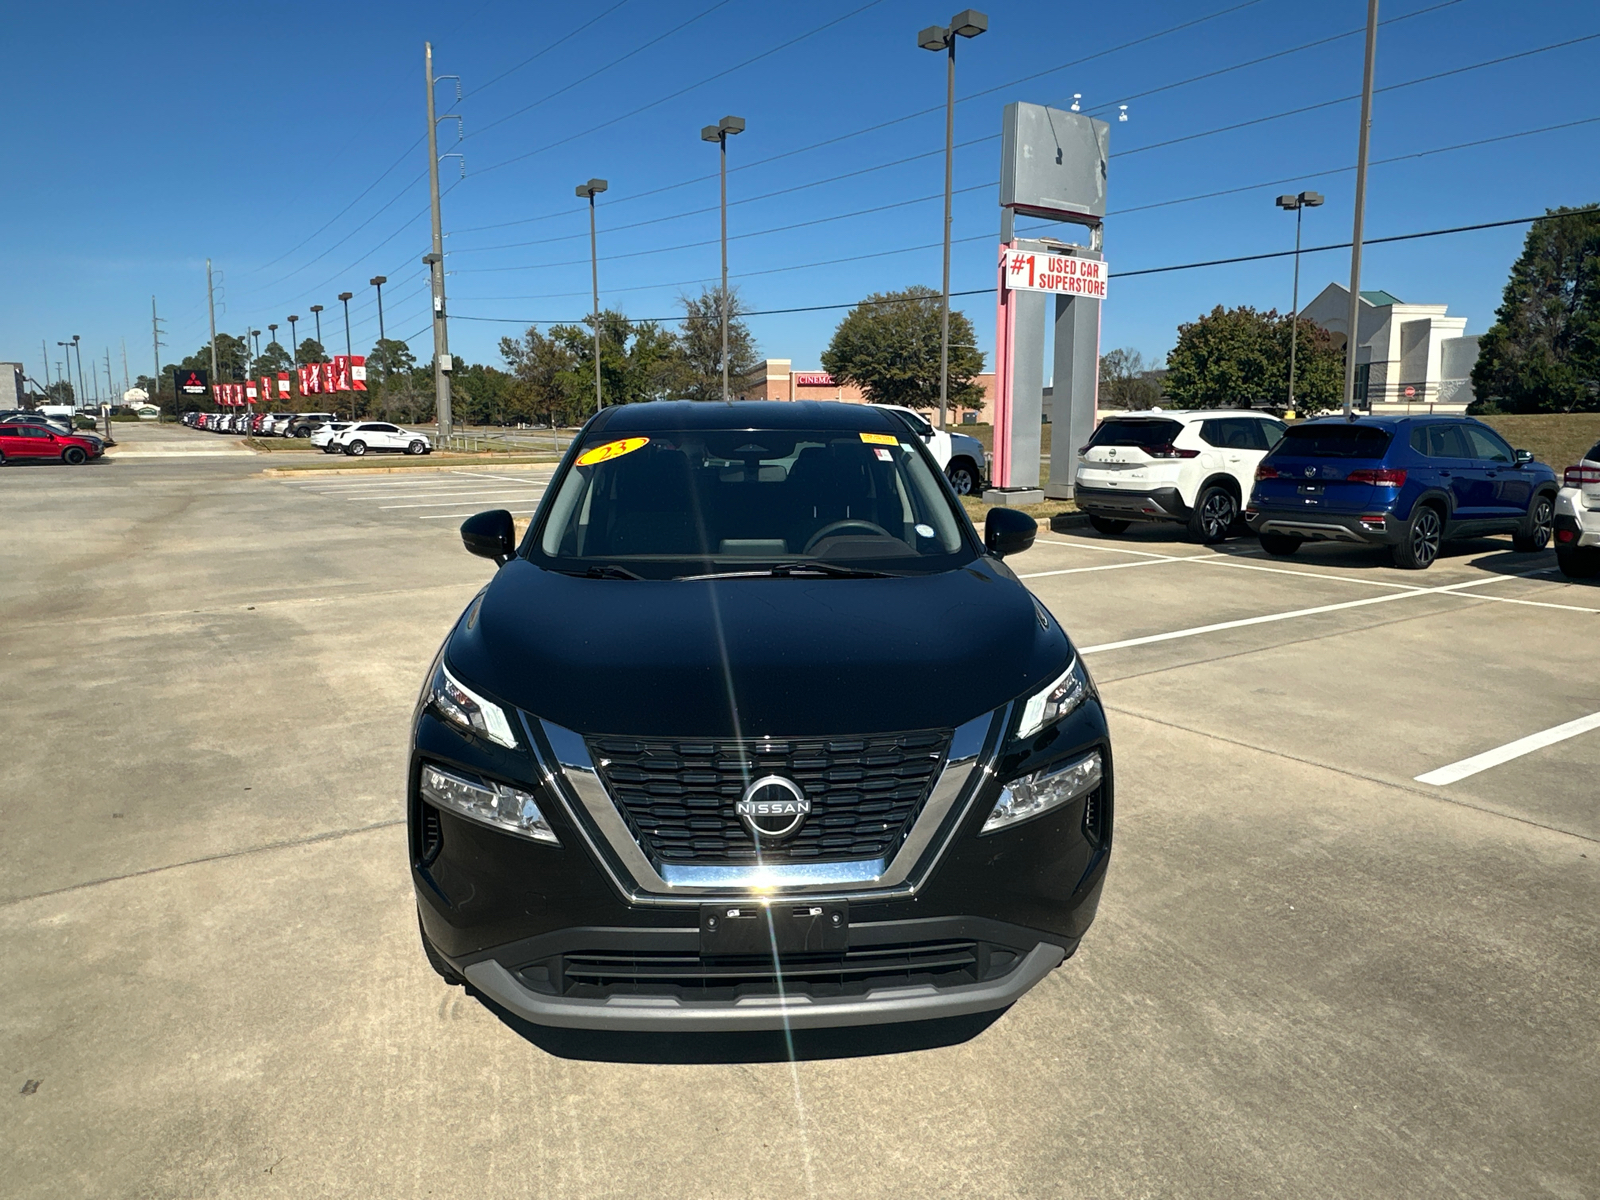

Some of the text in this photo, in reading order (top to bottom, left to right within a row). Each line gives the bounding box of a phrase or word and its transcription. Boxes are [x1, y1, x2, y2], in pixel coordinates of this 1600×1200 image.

[1010, 254, 1036, 287] #1
[1048, 257, 1100, 279] USED CAR
[1039, 274, 1105, 296] SUPERSTORE
[599, 441, 627, 461] 23
[738, 801, 809, 814] NISSAN
